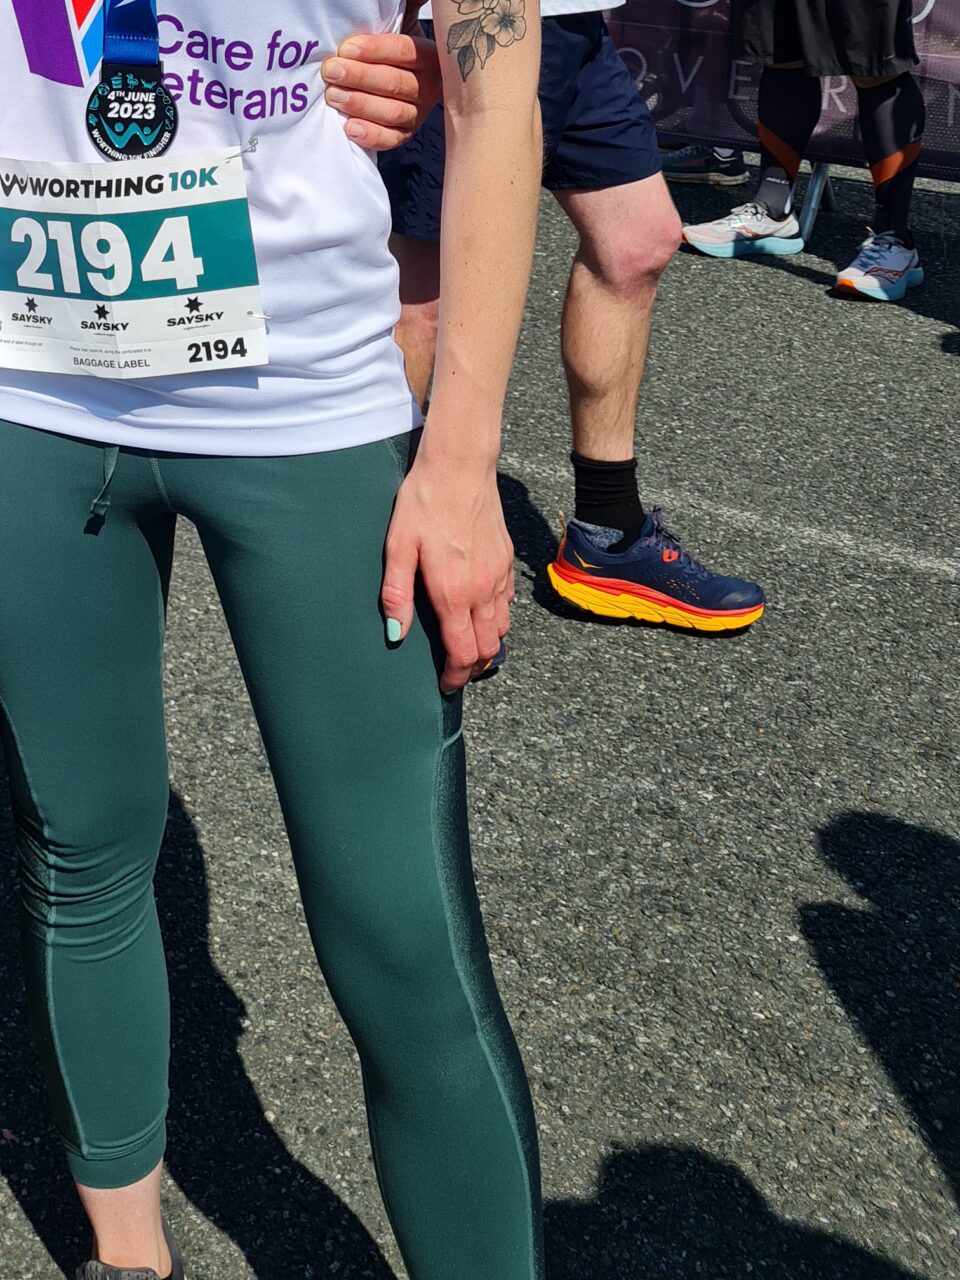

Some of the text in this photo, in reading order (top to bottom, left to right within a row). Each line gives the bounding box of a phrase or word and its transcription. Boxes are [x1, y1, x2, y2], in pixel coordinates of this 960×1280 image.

[157, 14, 319, 71] Care for
[124, 91, 156, 103] JUNE
[161, 69, 309, 120] eterans
[107, 102, 157, 120] 2023
[92, 128, 128, 160] WORTHING
[143, 130, 172, 159] FINISHER
[30, 165, 219, 199] WORTHING 10K
[10, 215, 205, 297] 2194
[11, 312, 53, 325] SAYSKY
[81, 320, 129, 332] SAYSKY
[167, 310, 225, 327] SAYSKY
[187, 337, 248, 363] 2194
[73, 357, 150, 369] BAGGAGE LABEL
